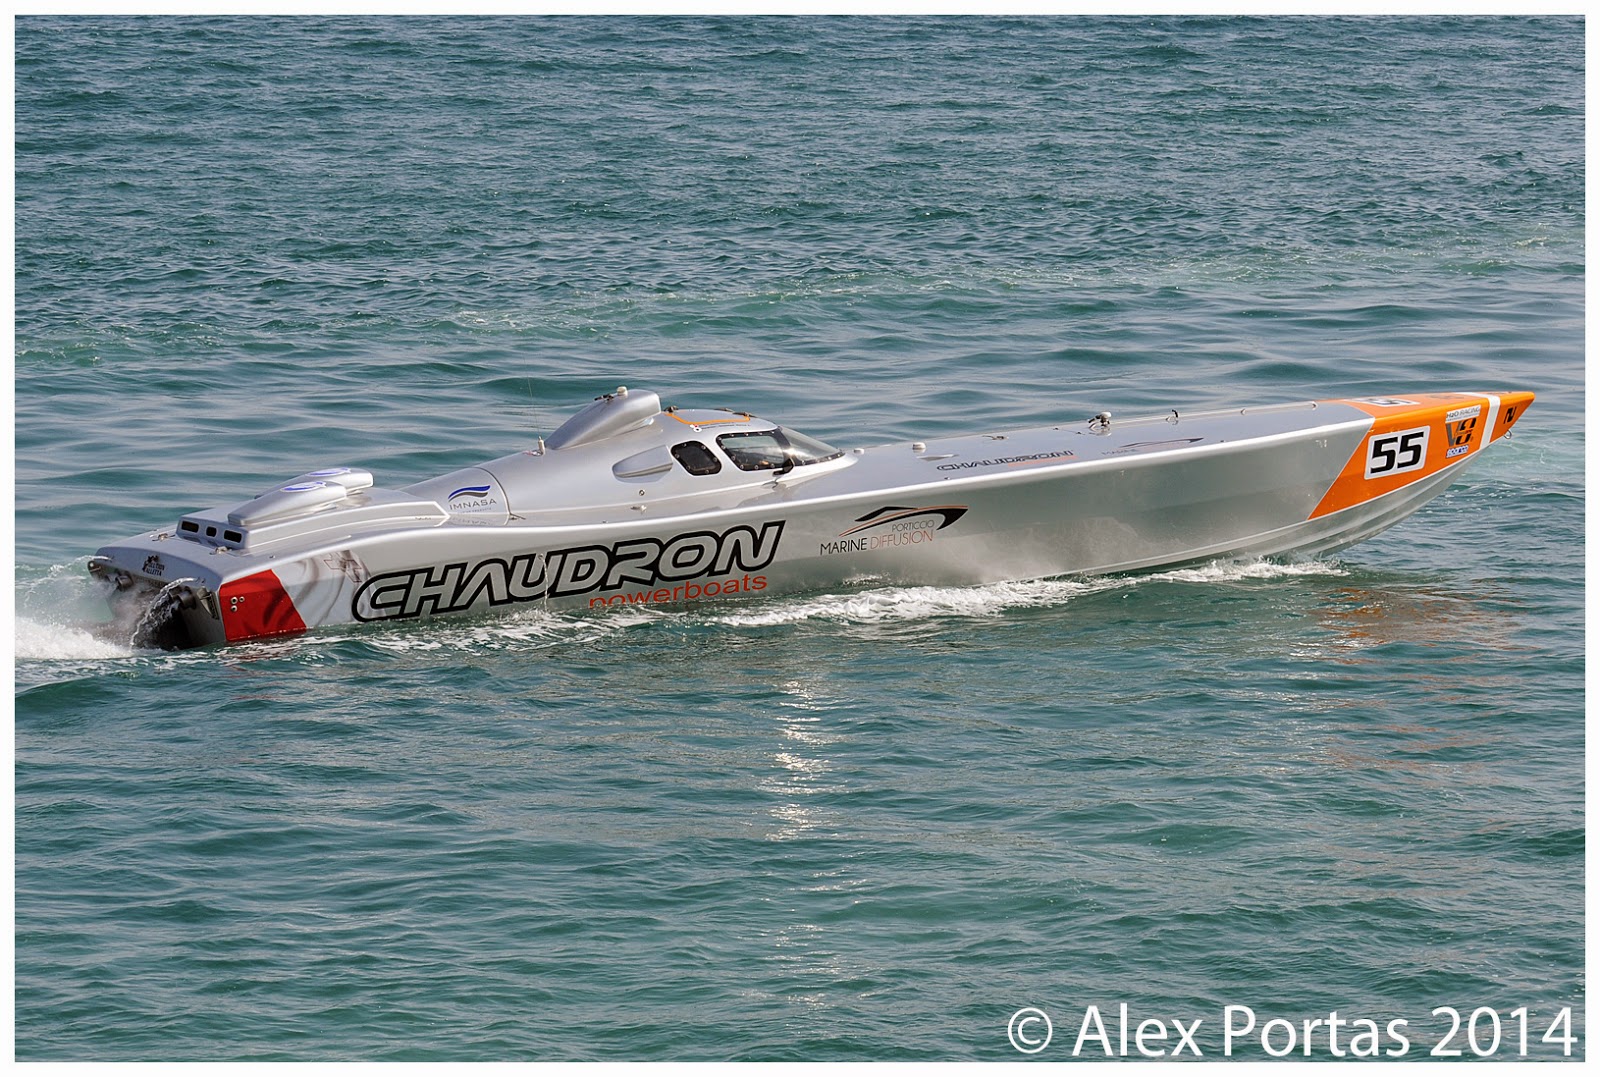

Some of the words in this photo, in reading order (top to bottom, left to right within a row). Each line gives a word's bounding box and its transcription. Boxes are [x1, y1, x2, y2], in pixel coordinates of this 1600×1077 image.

[936, 449, 1074, 471] CHAUDRON
[1370, 431, 1424, 474] 55
[448, 498, 498, 511] IMNASA
[891, 519, 935, 533] PORTICCIO
[820, 537, 868, 556] MARINE
[870, 529, 934, 550] DIFFUSION
[351, 520, 786, 623] CHAUDRON
